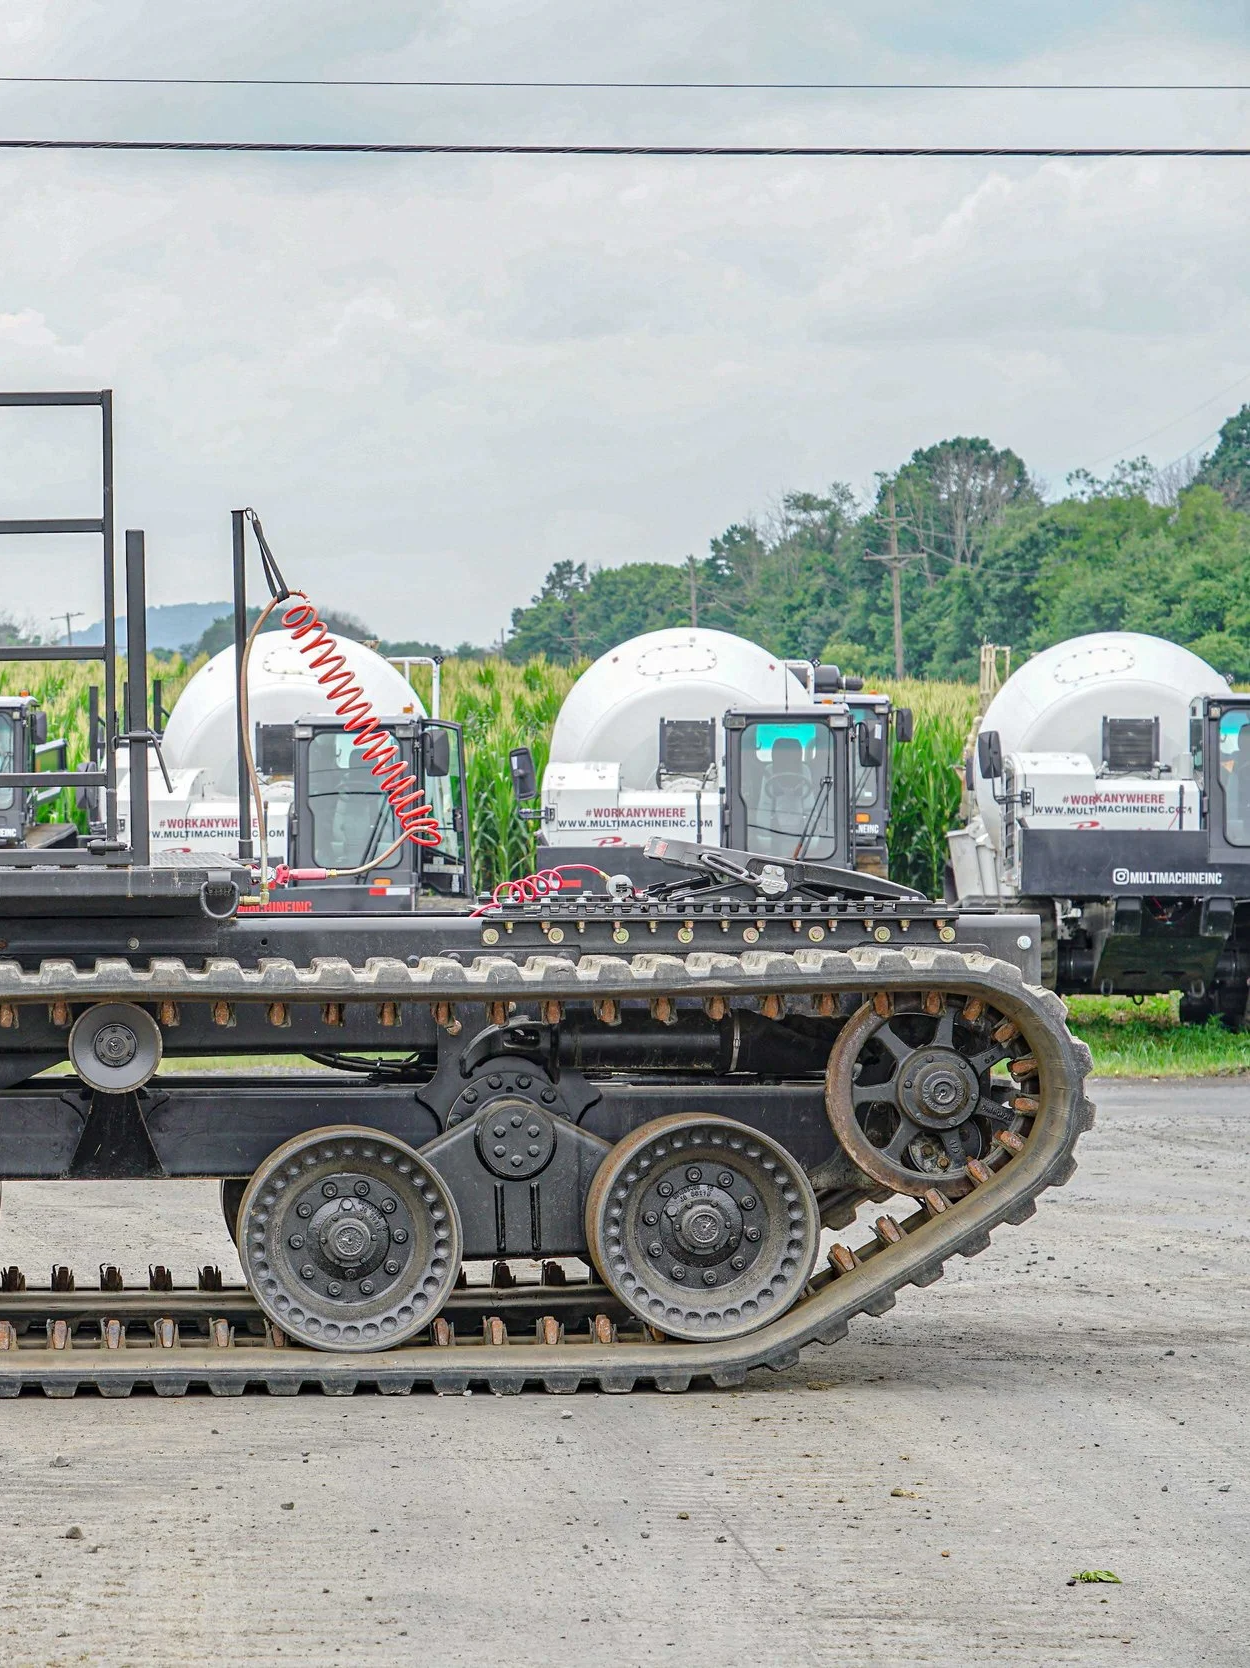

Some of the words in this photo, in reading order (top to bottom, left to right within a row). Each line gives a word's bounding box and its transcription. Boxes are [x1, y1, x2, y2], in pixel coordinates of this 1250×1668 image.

[1062, 794, 1165, 805] #WORKANYWHERE
[585, 808, 686, 818] #WORKANYWHERE
[159, 818, 259, 829] #WORKANYWHE
[1130, 871, 1222, 885] MULTIMACHINEINC
